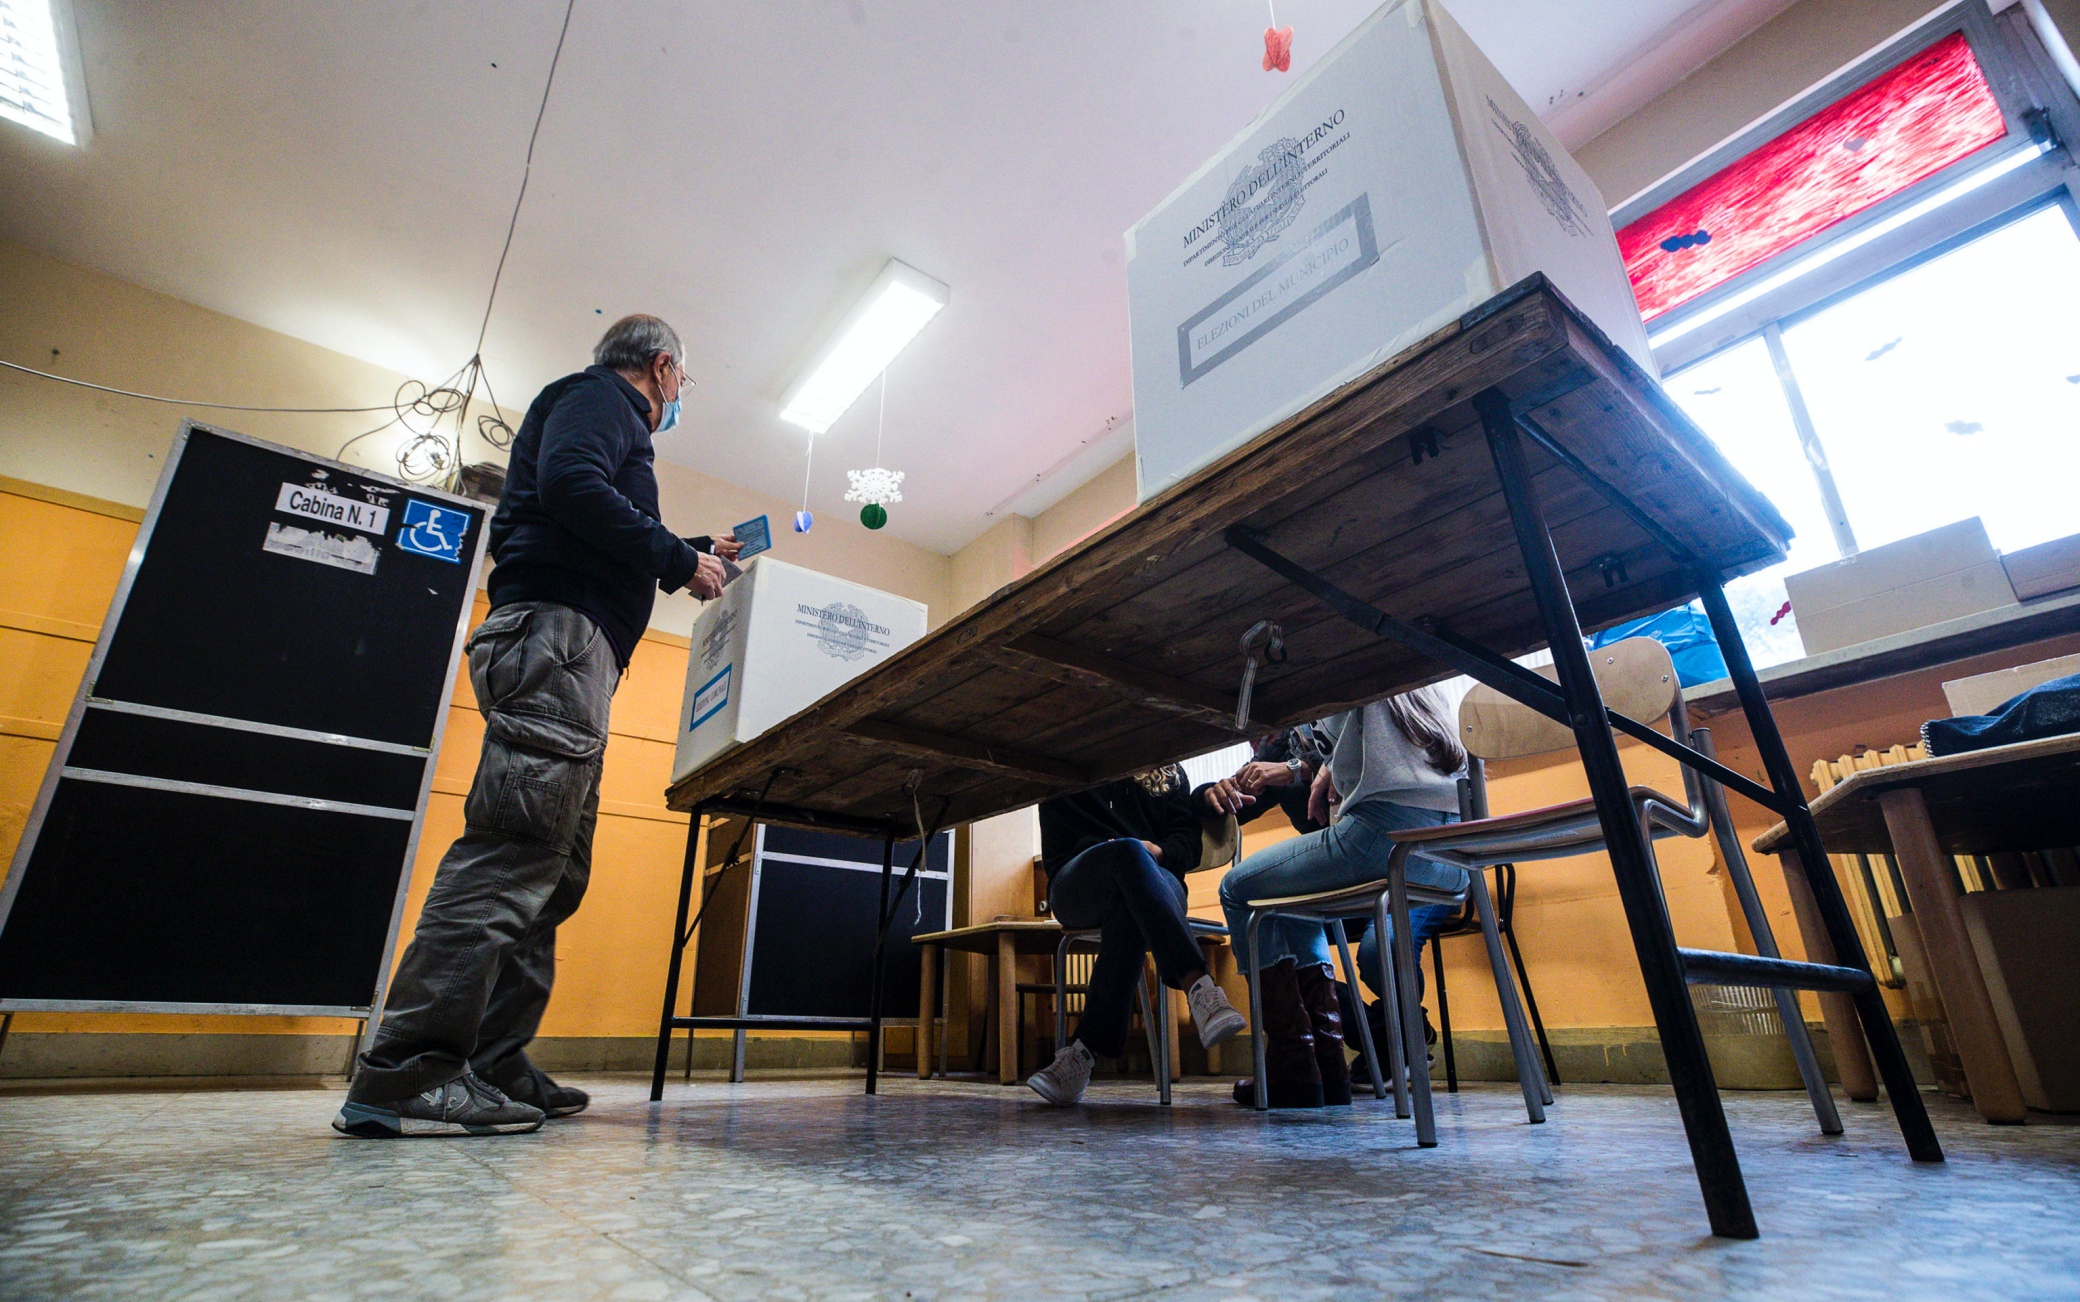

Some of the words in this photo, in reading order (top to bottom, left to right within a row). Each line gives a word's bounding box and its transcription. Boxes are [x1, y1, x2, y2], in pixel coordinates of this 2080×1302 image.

[1303, 132, 1351, 172] TERRITORIALI
[1183, 190, 1246, 249] MINISTERO
[1249, 109, 1345, 196] DELL'INTERNO
[1196, 306, 1250, 350] ELEZIONI
[1252, 290, 1277, 313] DEL
[1278, 238, 1349, 296] MUNICIPIO
[289, 490, 344, 521] Cabina
[347, 504, 362, 525] N.
[369, 510, 376, 528] 1
[797, 603, 838, 621] MINISTERO
[839, 615, 891, 636] DELL'INTERNO
